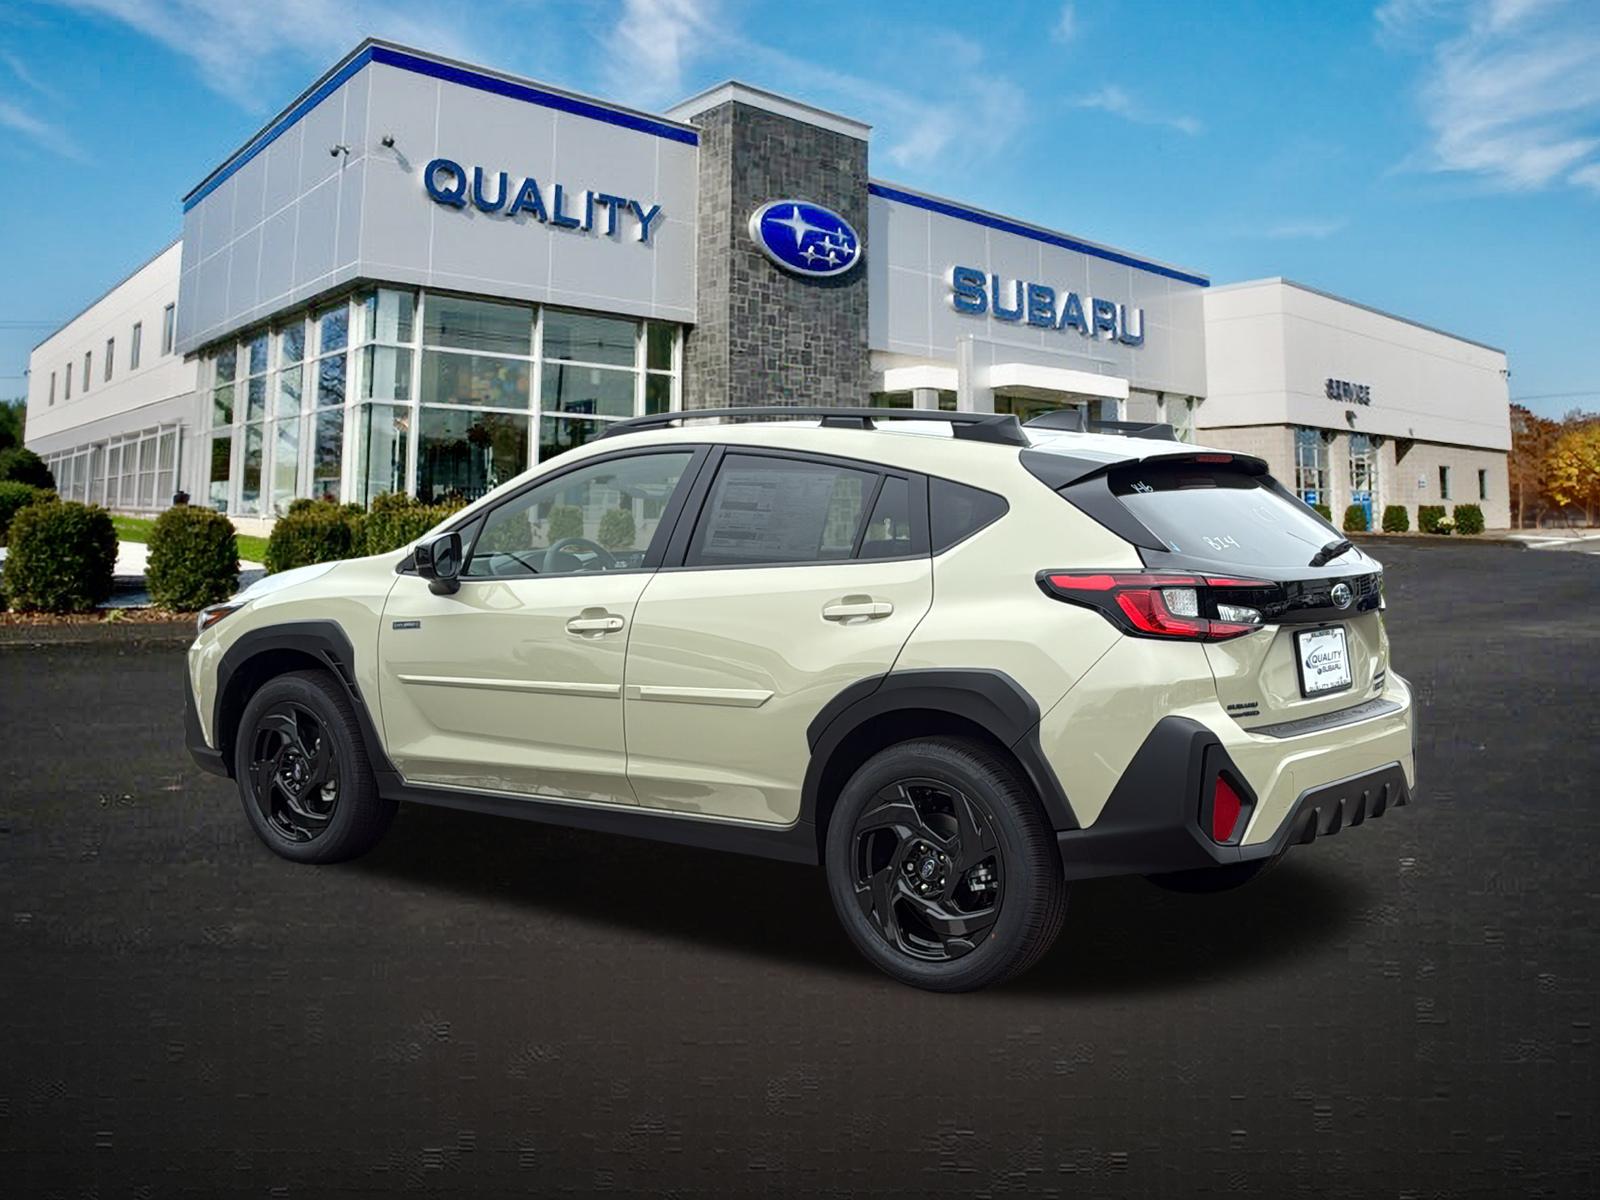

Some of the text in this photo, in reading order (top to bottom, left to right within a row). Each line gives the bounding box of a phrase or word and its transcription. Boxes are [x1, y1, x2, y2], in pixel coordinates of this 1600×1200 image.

[423, 158, 663, 243] QUALITY
[951, 265, 1145, 346] SUBARU
[1325, 378, 1371, 406] SERVICE
[1311, 650, 1342, 664] QUALITY
